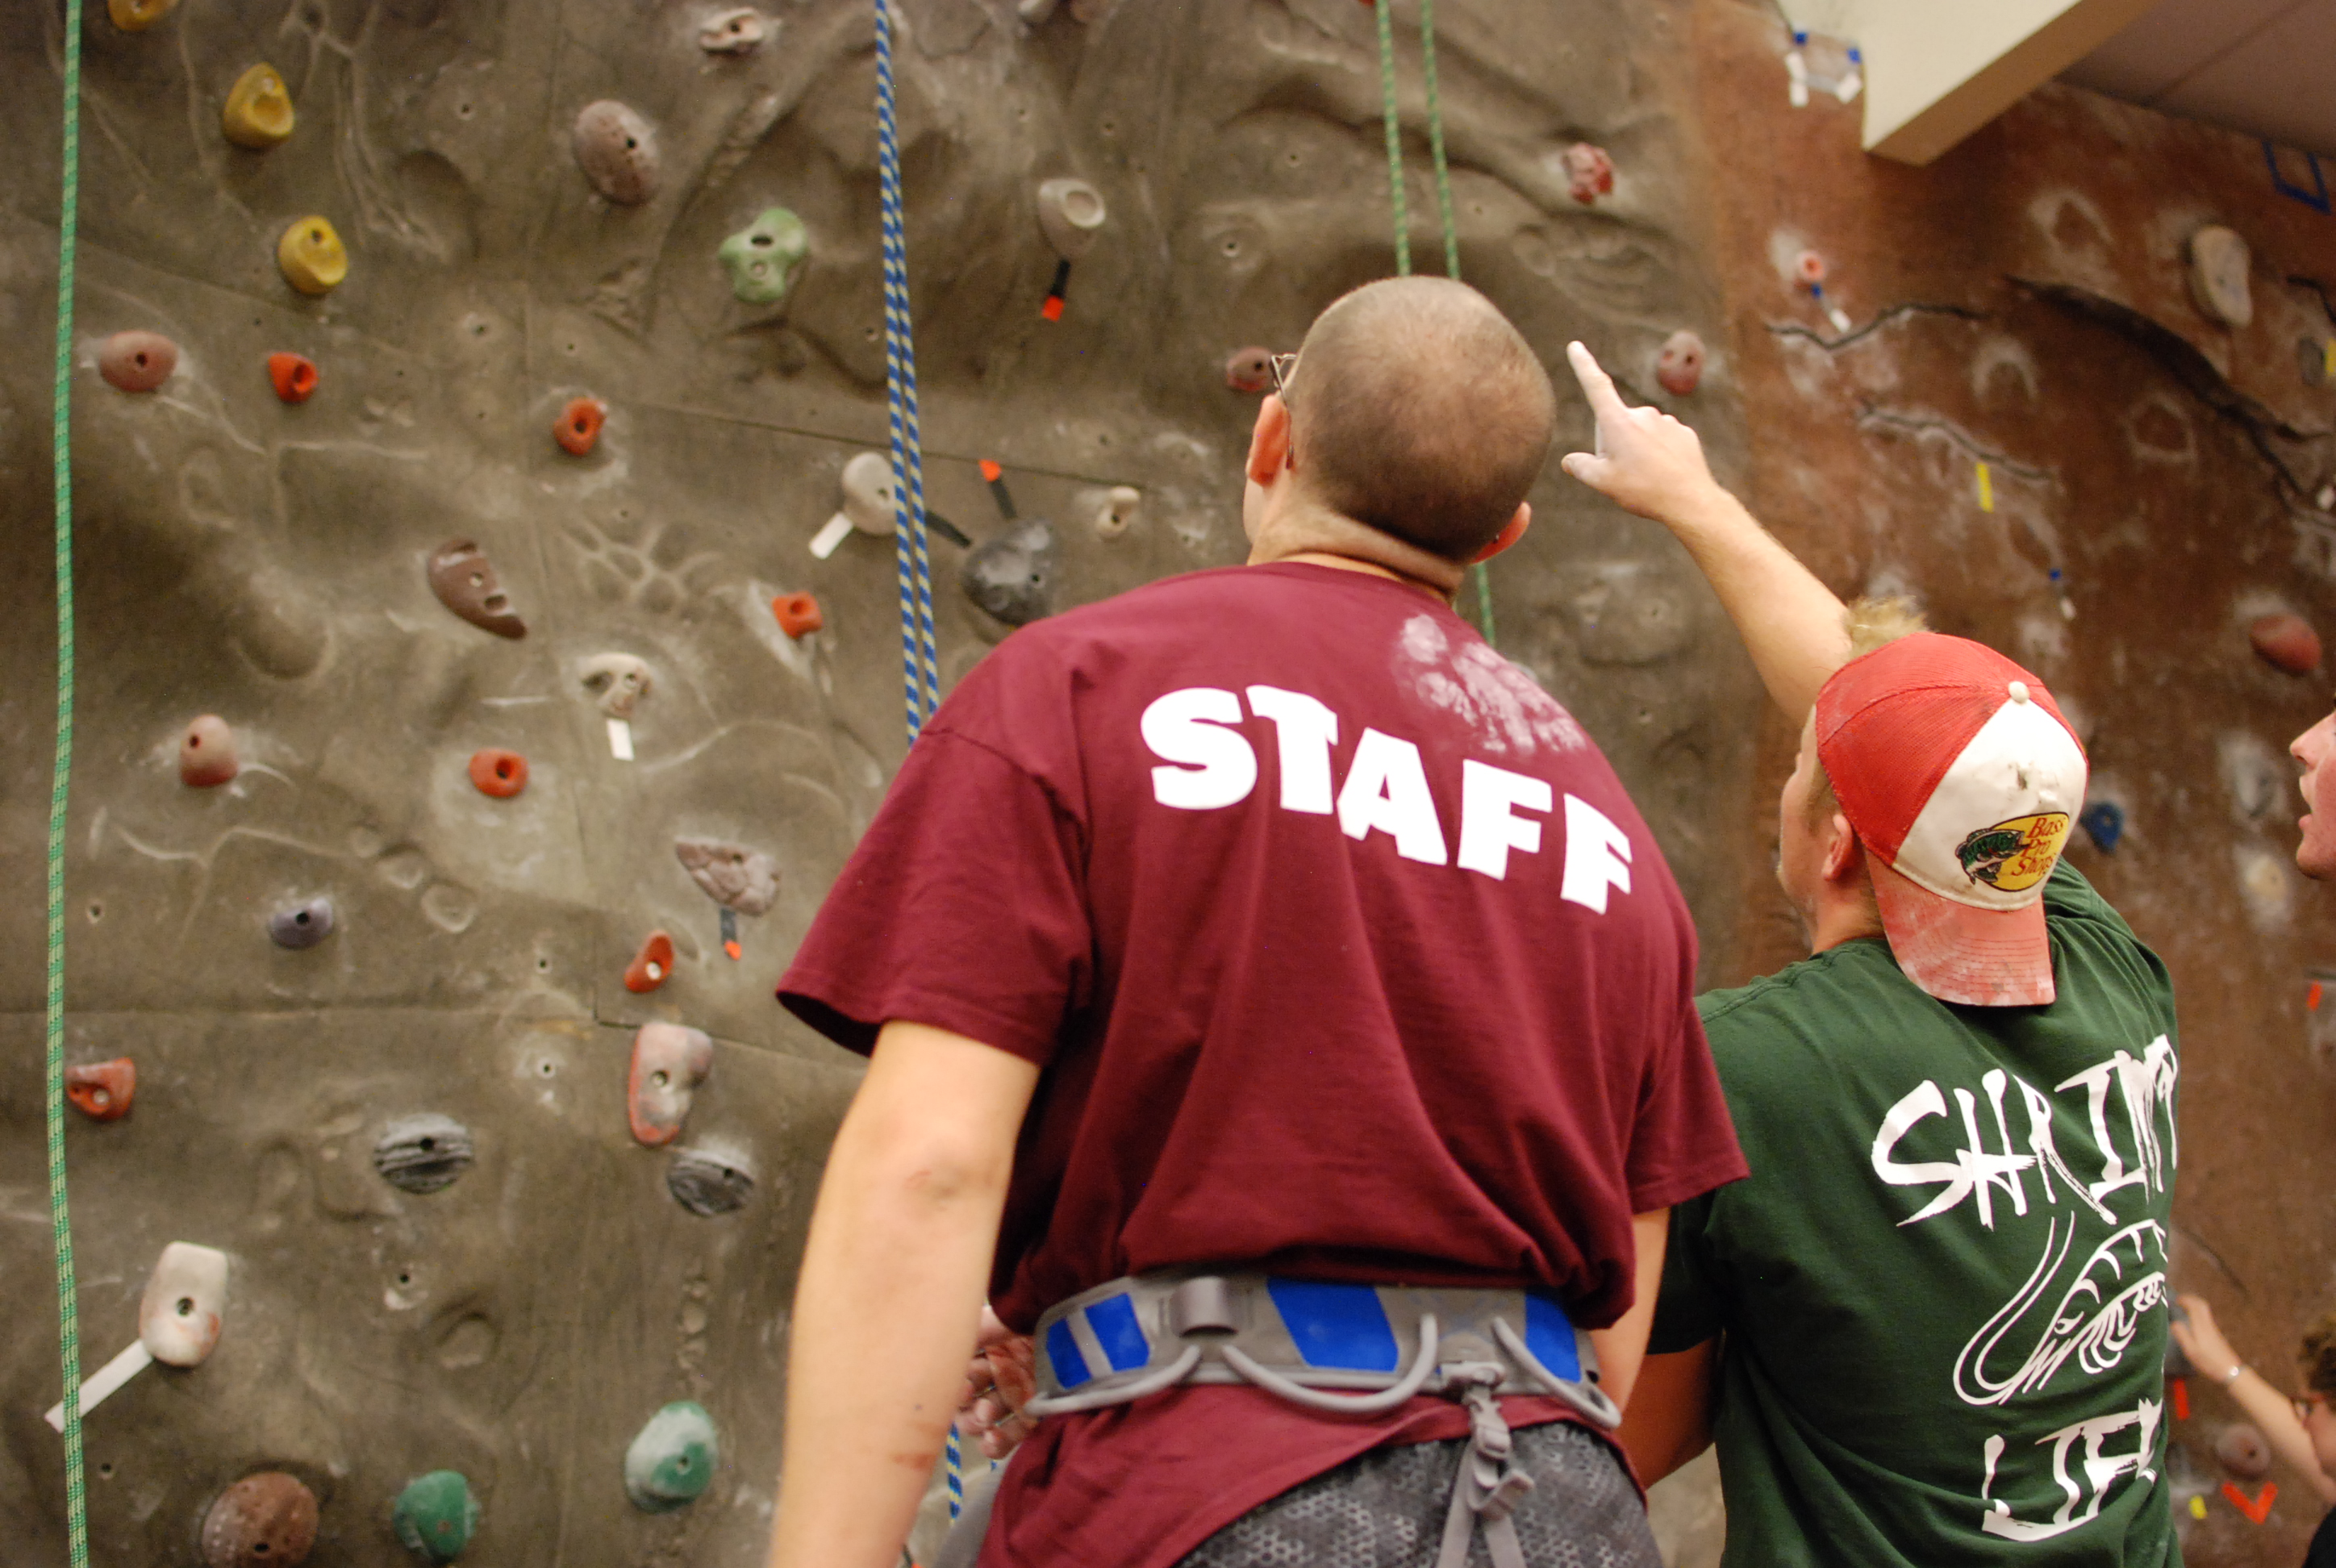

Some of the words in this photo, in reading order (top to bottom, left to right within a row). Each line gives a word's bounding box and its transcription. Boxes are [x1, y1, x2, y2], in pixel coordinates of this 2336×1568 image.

[1141, 685, 1633, 915] STAFF
[2026, 817, 2063, 839] Bass
[2021, 838, 2051, 857] Pro
[2012, 855, 2054, 877] Shops
